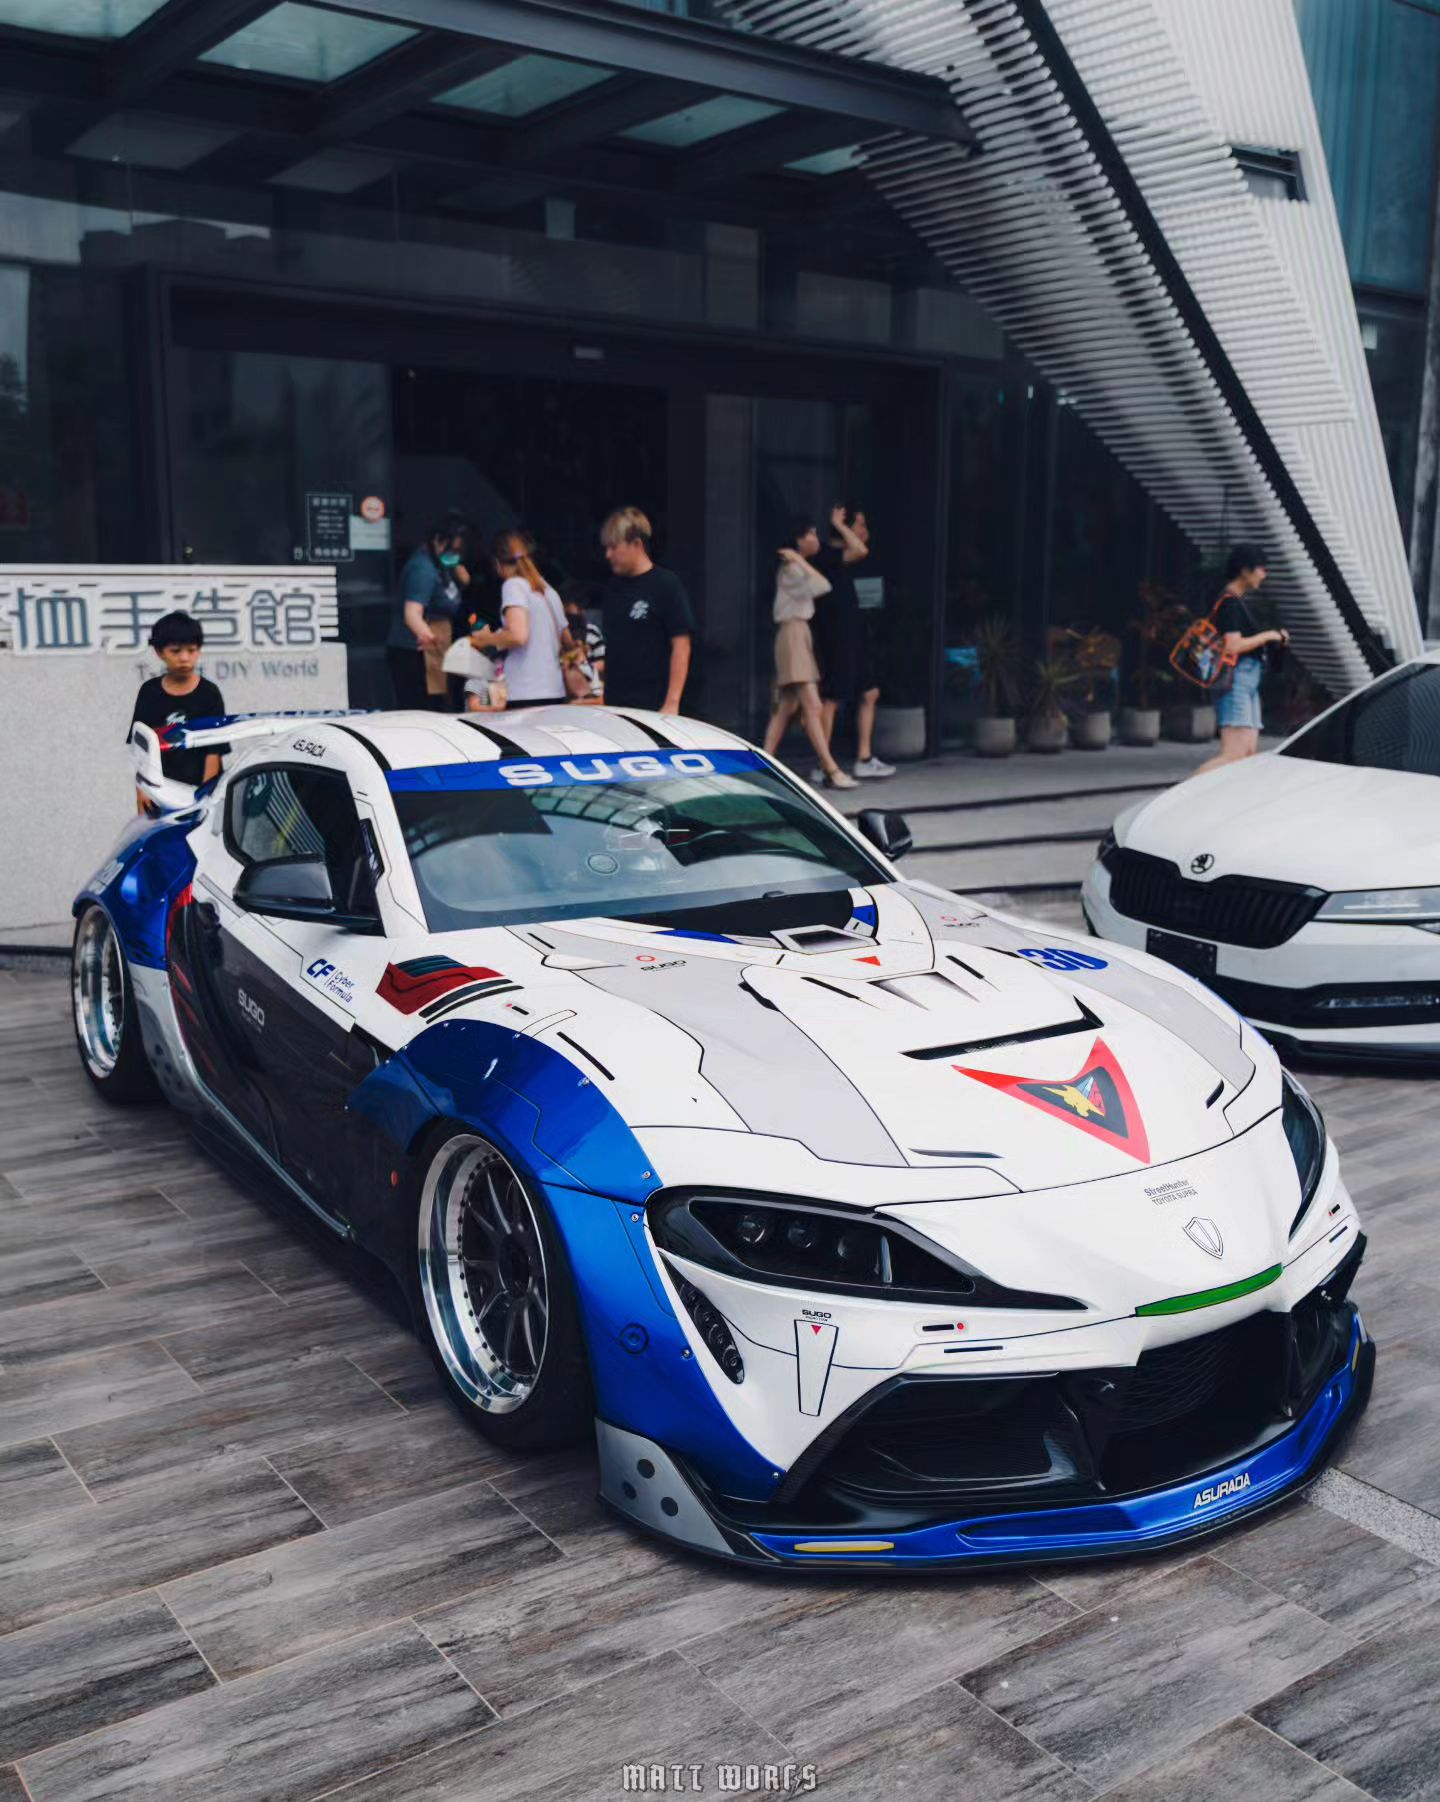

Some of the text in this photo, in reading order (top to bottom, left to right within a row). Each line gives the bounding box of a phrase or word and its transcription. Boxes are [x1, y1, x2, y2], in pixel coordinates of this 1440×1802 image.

[215, 660, 248, 680] DIY
[261, 659, 319, 679] World
[498, 753, 716, 786] SUGO
[306, 958, 336, 979] CF
[1016, 947, 1109, 971] 30
[326, 979, 353, 1003] Formula
[334, 971, 355, 989] Cyber
[237, 988, 265, 1027] SUGO
[1152, 1188, 1198, 1207] TOYOTA SUPRA
[801, 1309, 832, 1319] SUGO
[1193, 1472, 1251, 1509] ASURADA
